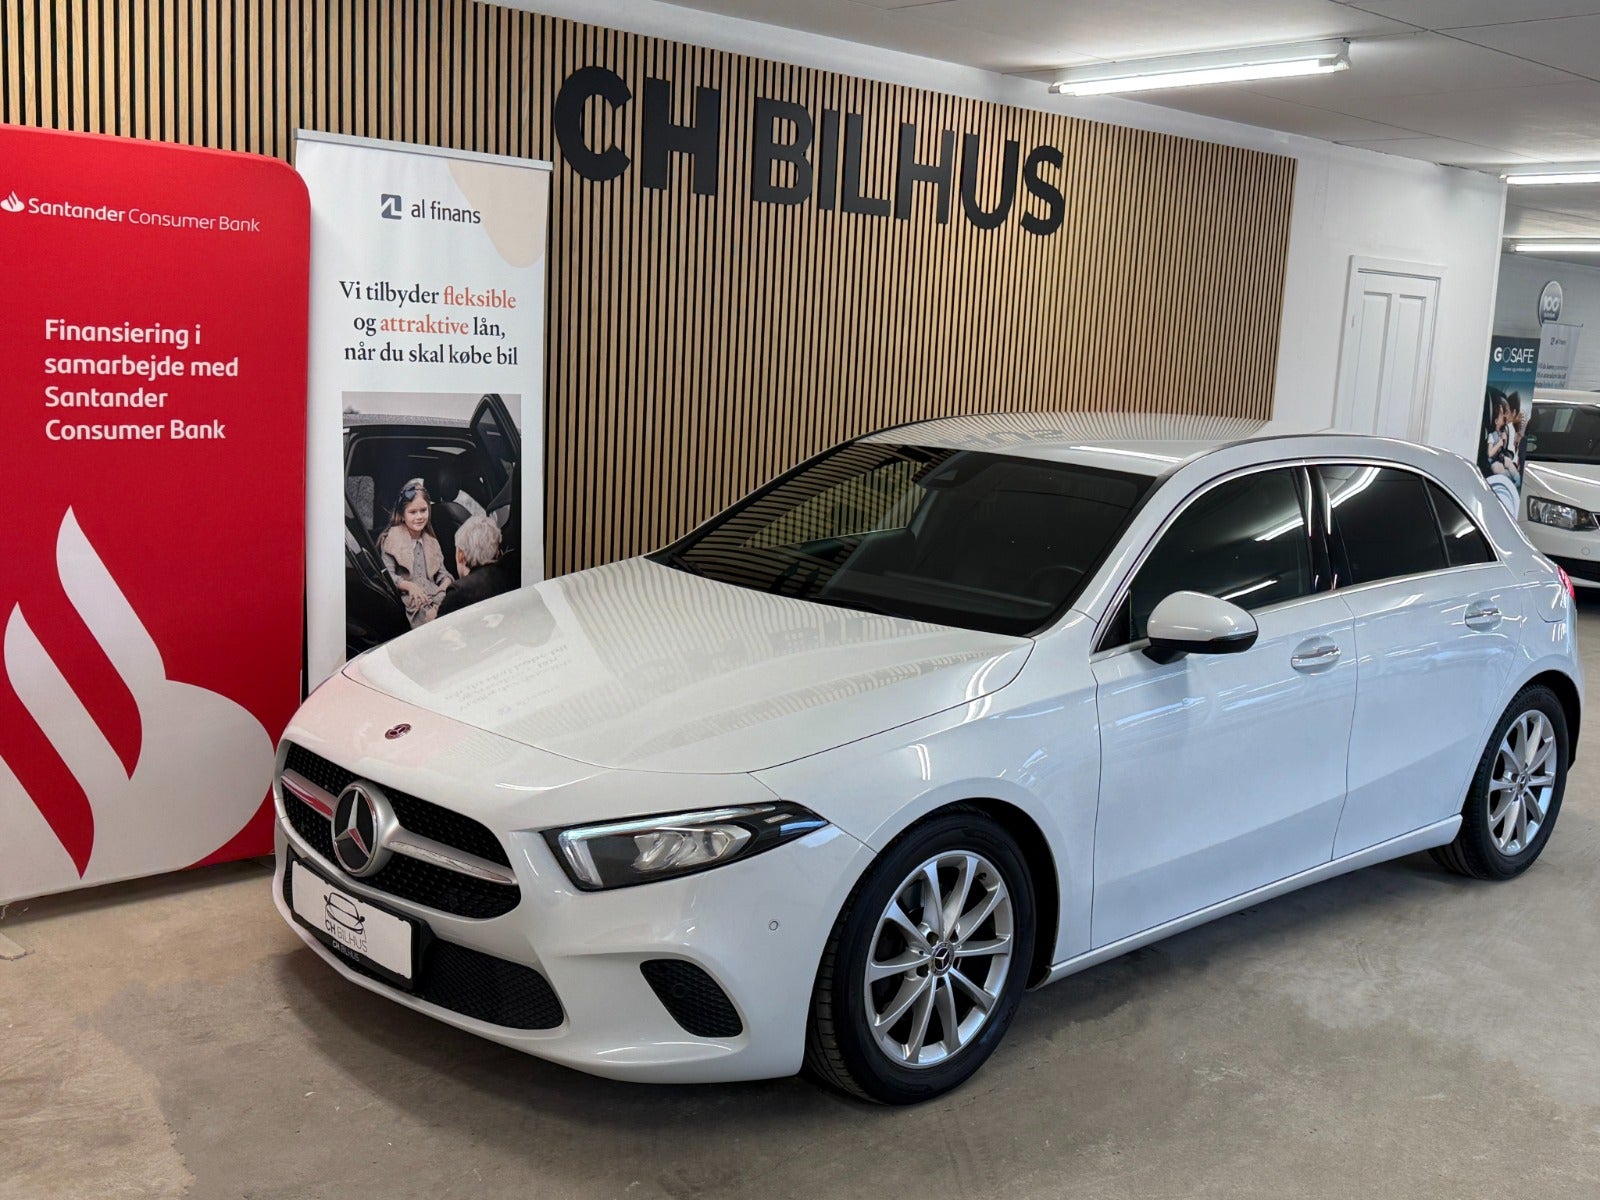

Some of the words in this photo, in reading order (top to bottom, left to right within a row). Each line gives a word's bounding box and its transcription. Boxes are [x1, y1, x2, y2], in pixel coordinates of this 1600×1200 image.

[555, 66, 721, 196] CH
[752, 96, 1065, 236] BILHUS
[28, 198, 126, 222] Santander
[128, 208, 216, 230] Consumer
[218, 216, 261, 233] Bank
[410, 199, 426, 219] al
[430, 200, 481, 224] finans
[339, 280, 362, 301] Vi
[366, 282, 440, 308] tilbyder
[443, 286, 517, 309] fleksible
[45, 319, 189, 350] Finansiering
[195, 323, 202, 345] i
[353, 316, 376, 337] og
[380, 314, 469, 336] attraktive
[473, 316, 506, 339] lån,
[344, 341, 376, 361] når
[380, 341, 404, 362] du
[408, 343, 445, 364] skal
[448, 344, 492, 365] købe
[496, 345, 518, 365] bil
[1493, 346, 1534, 364] GOSAFE
[45, 354, 184, 381] samarbejde
[190, 357, 239, 377] med
[45, 386, 168, 409] Santander
[45, 419, 165, 441] Consumer
[170, 420, 226, 440] Bank
[325, 919, 336, 935] CH
[336, 926, 368, 953] BILHUS
